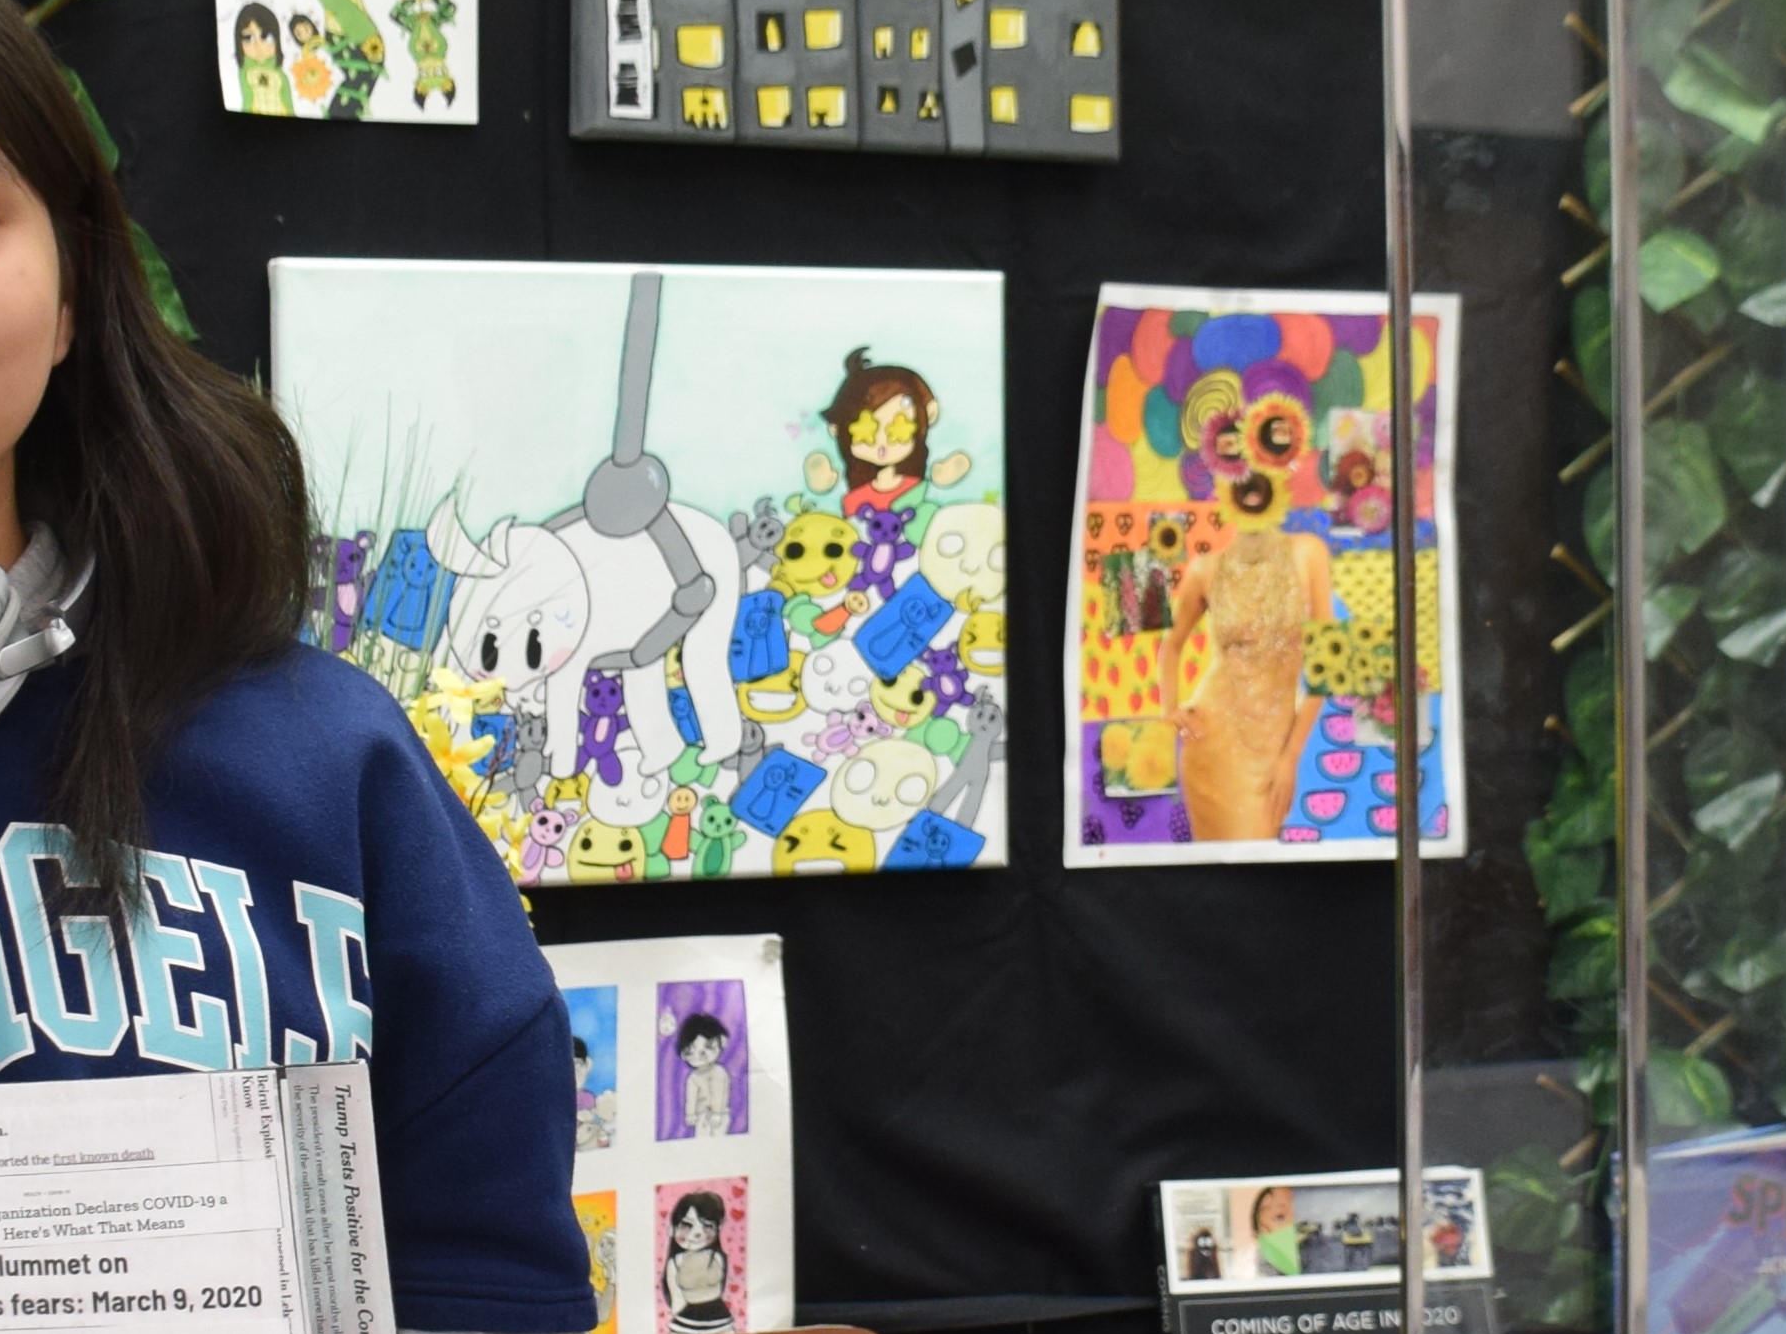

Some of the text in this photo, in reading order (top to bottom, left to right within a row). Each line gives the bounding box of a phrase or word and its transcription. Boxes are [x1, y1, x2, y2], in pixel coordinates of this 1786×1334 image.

[241, 1075, 254, 1109] Know
[334, 1084, 351, 1138] Trump
[31, 1153, 51, 1166] the
[53, 1152, 77, 1166] first
[78, 1150, 120, 1164] known
[120, 1147, 155, 1161] death
[339, 1141, 356, 1181] Tests
[75, 1199, 140, 1217] Declares
[142, 1194, 217, 1212] COVID-19
[219, 1196, 229, 1206] a
[343, 1185, 363, 1247] Positive
[3, 1223, 51, 1241] Here's
[53, 1223, 95, 1238] What
[97, 1219, 134, 1234] That
[136, 1218, 186, 1233] Means
[98, 1255, 130, 1275] on
[351, 1251, 367, 1276] for
[10, 1290, 85, 1317] fears:
[91, 1289, 167, 1314] March
[172, 1287, 196, 1313] 9,
[200, 1285, 263, 1310] 2020
[353, 1279, 371, 1305] the
[1296, 1312, 1329, 1334] OF
[1332, 1309, 1376, 1332] AGE
[1378, 1308, 1403, 1328] IN
[1422, 1305, 1463, 1328] 020
